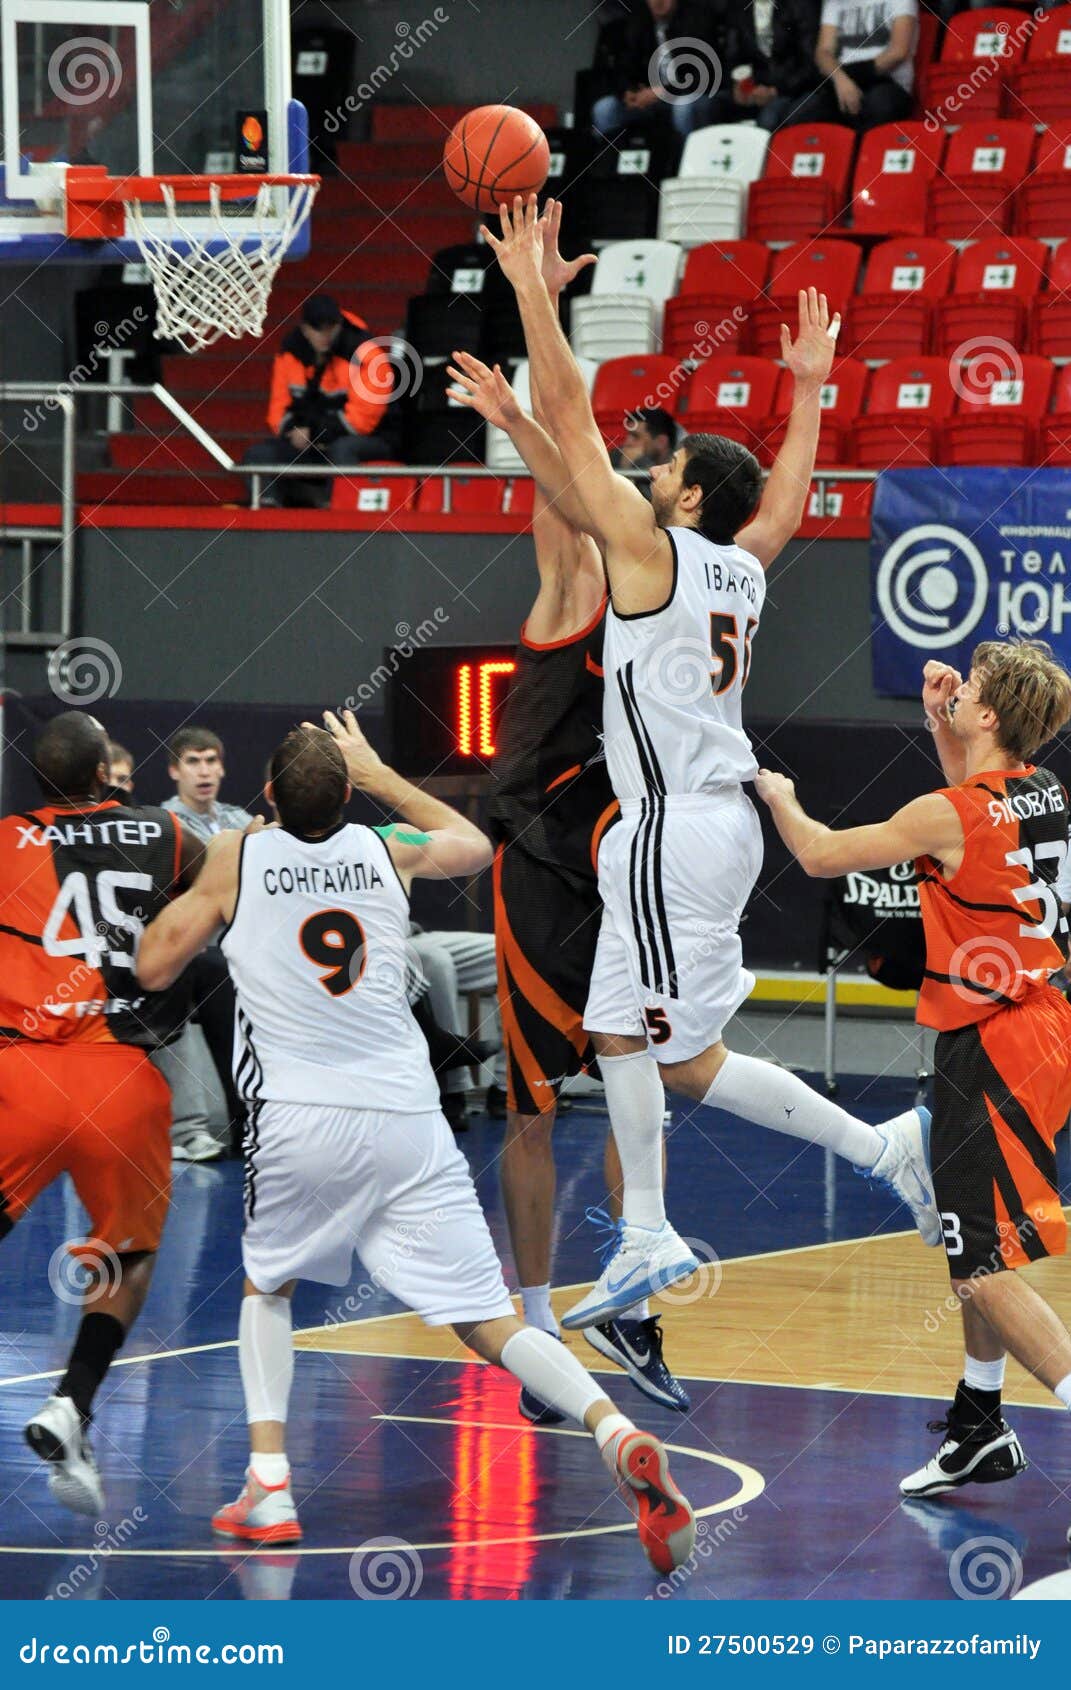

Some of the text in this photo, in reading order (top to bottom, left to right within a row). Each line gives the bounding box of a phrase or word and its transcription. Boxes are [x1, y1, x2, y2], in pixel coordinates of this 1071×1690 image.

[15, 820, 162, 849] ХАНТЕР
[263, 859, 385, 896] СОНГАЙЛА
[42, 870, 153, 973] 45
[297, 907, 368, 998] 9
[638, 1007, 672, 1046] 5
